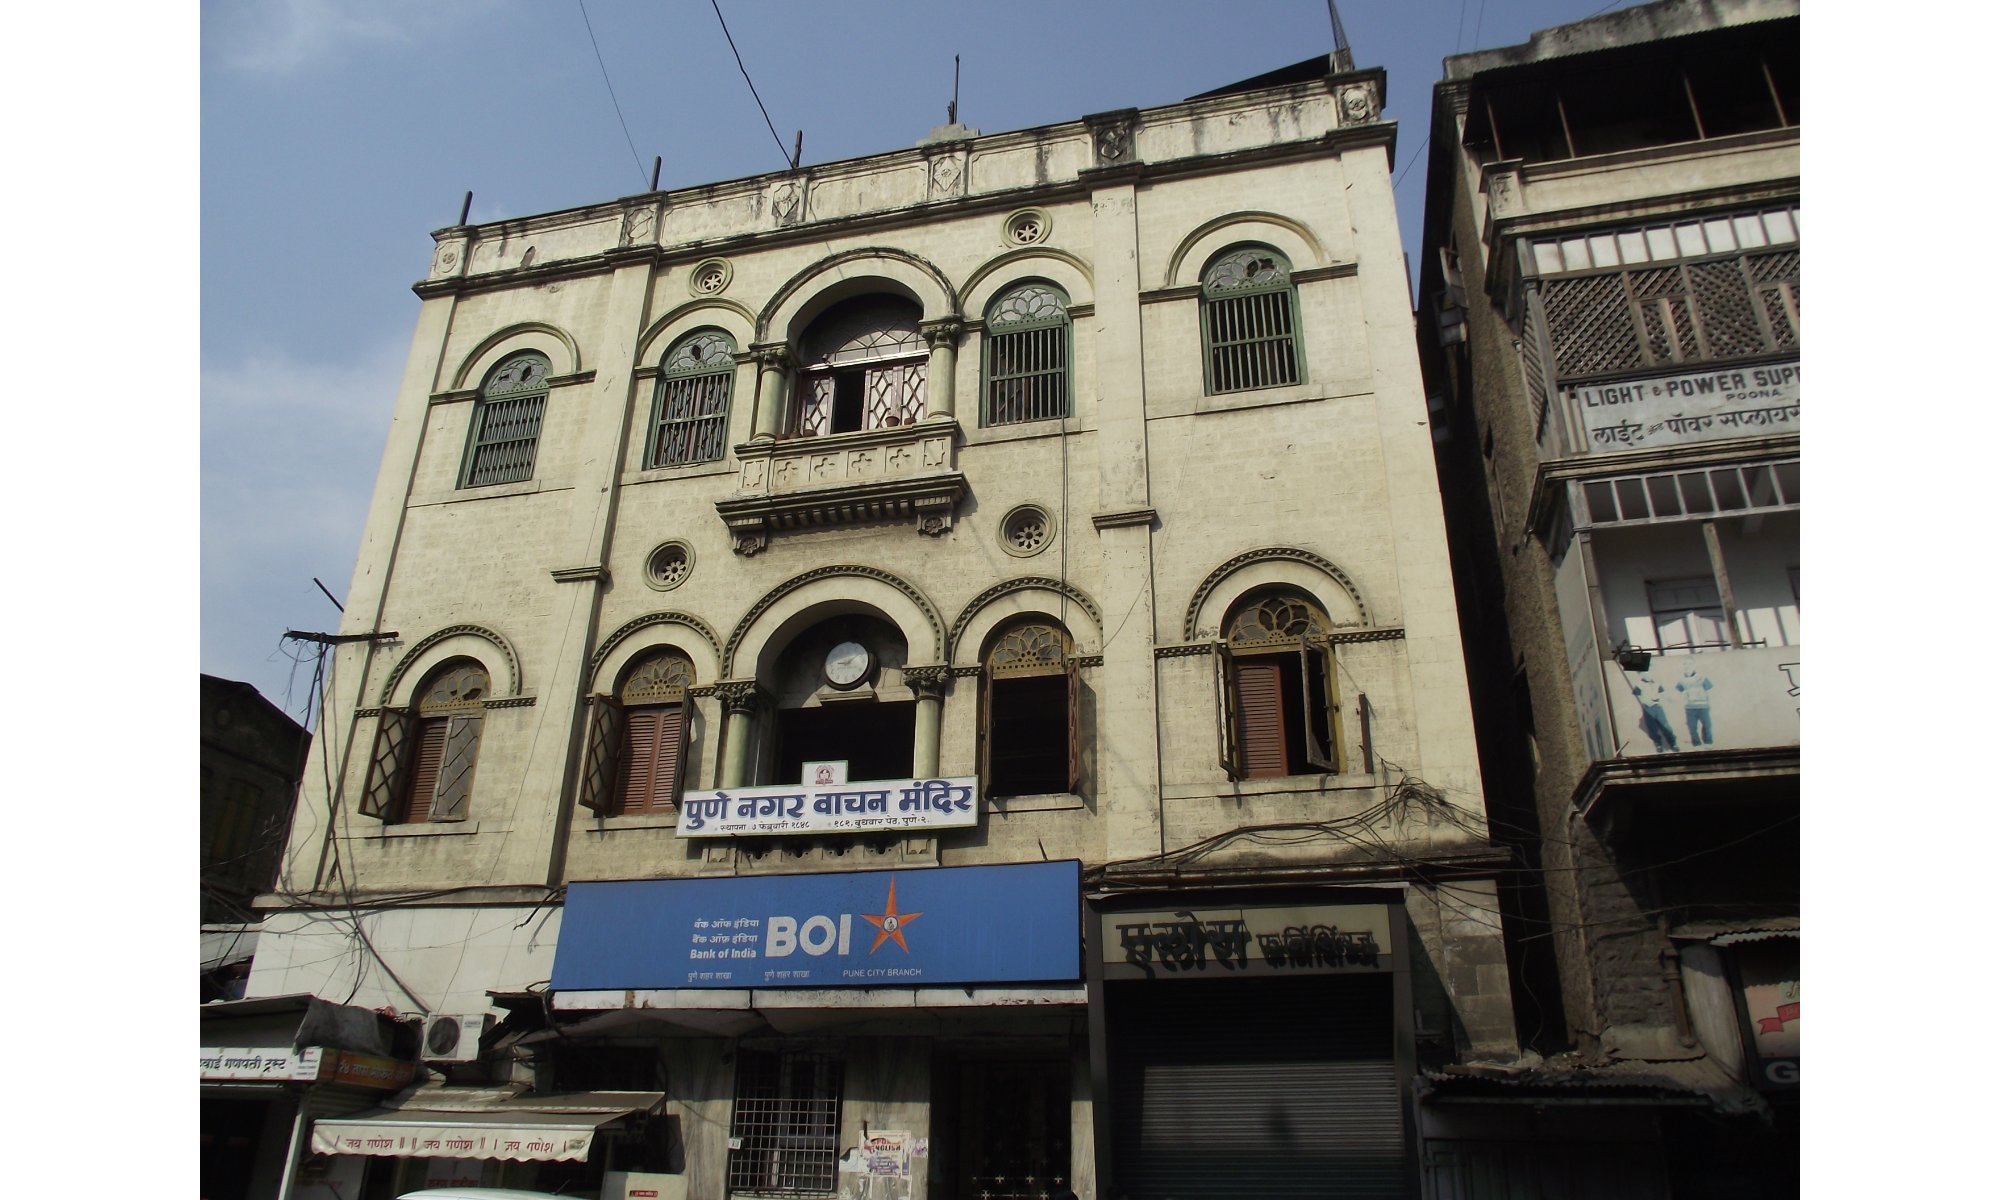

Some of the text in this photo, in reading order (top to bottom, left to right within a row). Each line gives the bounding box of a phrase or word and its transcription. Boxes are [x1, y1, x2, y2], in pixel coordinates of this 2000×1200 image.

[1584, 366, 1800, 408] LIGHT & POWER SUP
[1726, 388, 1782, 401] POONA
[1592, 419, 1645, 446] लाईट
[1665, 413, 1713, 434] पॉवर
[684, 780, 973, 831] पुणे नगर वाचन मंदिर
[720, 824, 746, 832] स्थापना
[854, 817, 884, 829] बुधवार
[694, 917, 708, 928] बँक
[733, 917, 759, 930] इंडिया
[692, 933, 707, 944] बैंक
[732, 932, 758, 945] इंडिया
[765, 913, 852, 957] BOI
[690, 948, 757, 959] Bank of India
[843, 968, 921, 977] PUNE CITY BRANCH
[200, 1055, 287, 1073] वाई गणपती ट्रस्ट
[345, 1139, 361, 1148] जय
[366, 1134, 393, 1149] गणेश
[424, 1140, 440, 1150] जय
[445, 1135, 473, 1150] गणेश
[504, 1140, 520, 1152] जय
[526, 1137, 554, 1153] गणेश
